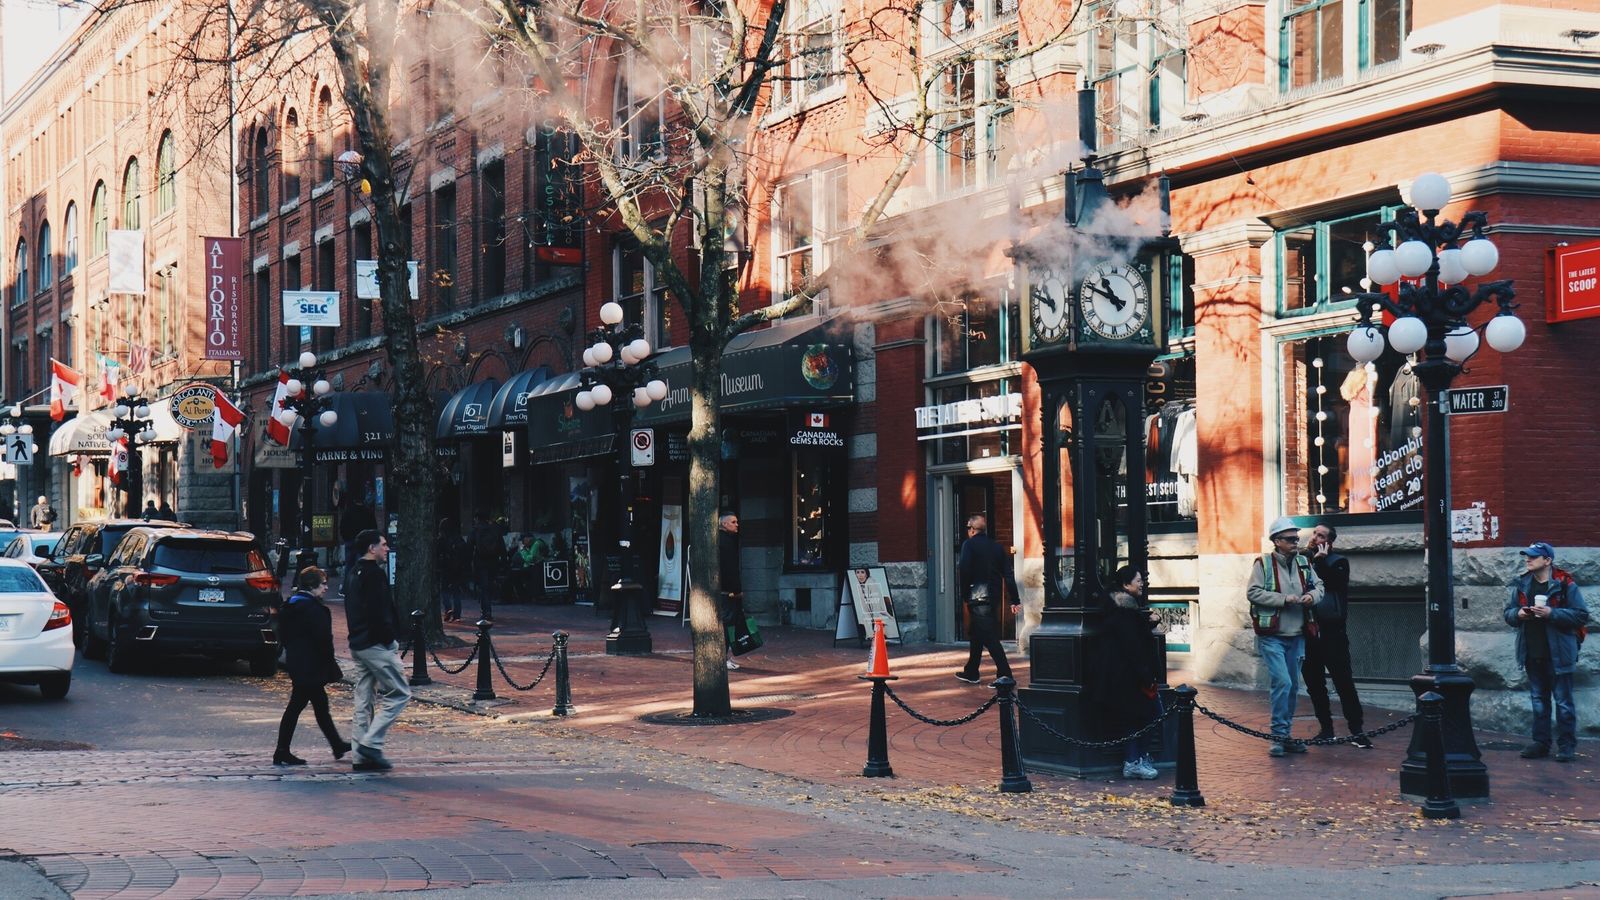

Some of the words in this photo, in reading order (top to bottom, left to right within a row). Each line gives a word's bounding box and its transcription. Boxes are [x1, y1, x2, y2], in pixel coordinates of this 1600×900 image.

[210, 240, 223, 269] AL
[1568, 270, 1577, 278] THE
[1579, 267, 1596, 277] LATEST
[1568, 277, 1597, 293] SCOOP
[209, 274, 226, 346] PORTO
[300, 303, 328, 314] SELC
[208, 349, 241, 357] ITALIANO
[1453, 392, 1485, 410] WATER
[1493, 390, 1500, 399] ST
[1491, 399, 1503, 408] 300
[467, 423, 486, 432] Organi
[364, 432, 381, 442] 321
[797, 431, 837, 439] CANADIAN
[790, 437, 811, 445] GEMS
[819, 438, 844, 447] ROCKS
[316, 451, 348, 461] CARNE
[1375, 468, 1403, 491] team
[1375, 489, 1404, 512] since
